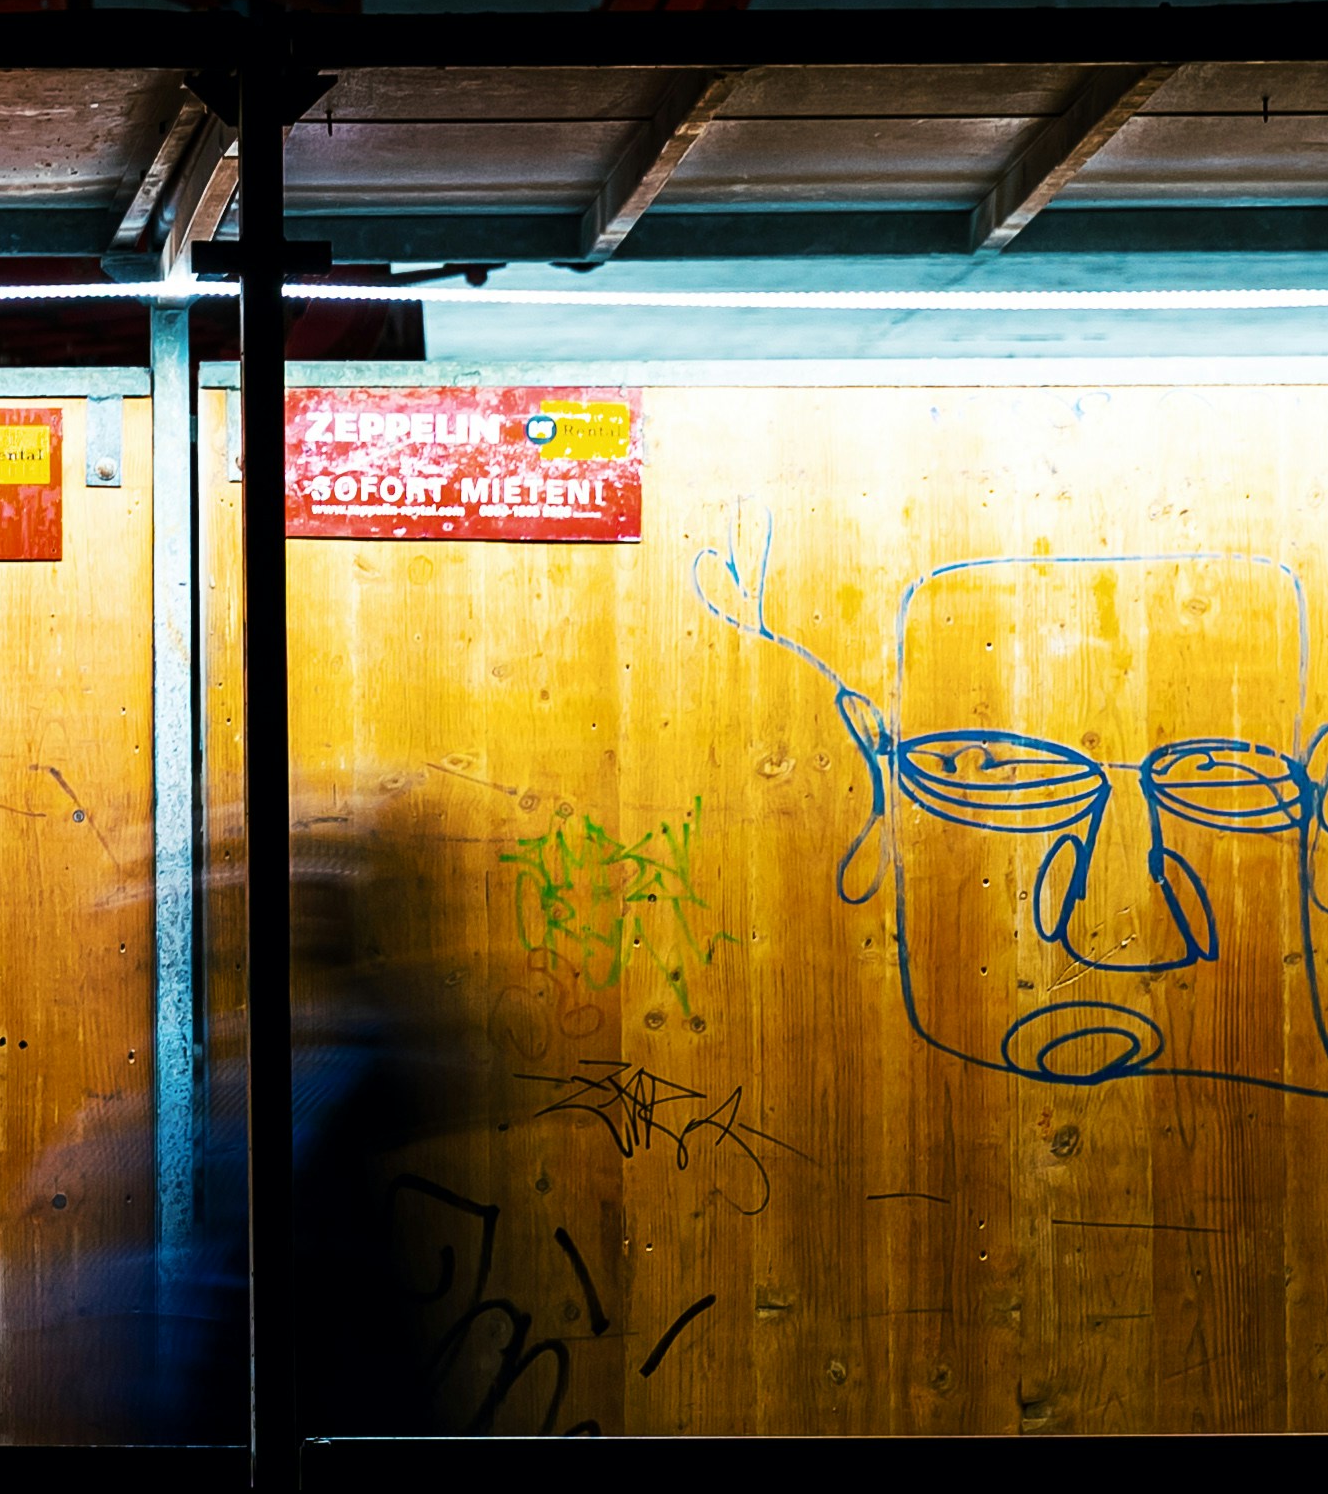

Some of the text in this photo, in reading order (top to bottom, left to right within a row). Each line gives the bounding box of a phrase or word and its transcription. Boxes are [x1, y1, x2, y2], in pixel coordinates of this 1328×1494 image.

[304, 412, 501, 444] ZEPPELIN
[309, 476, 606, 506] SOFORT MIETEN!
